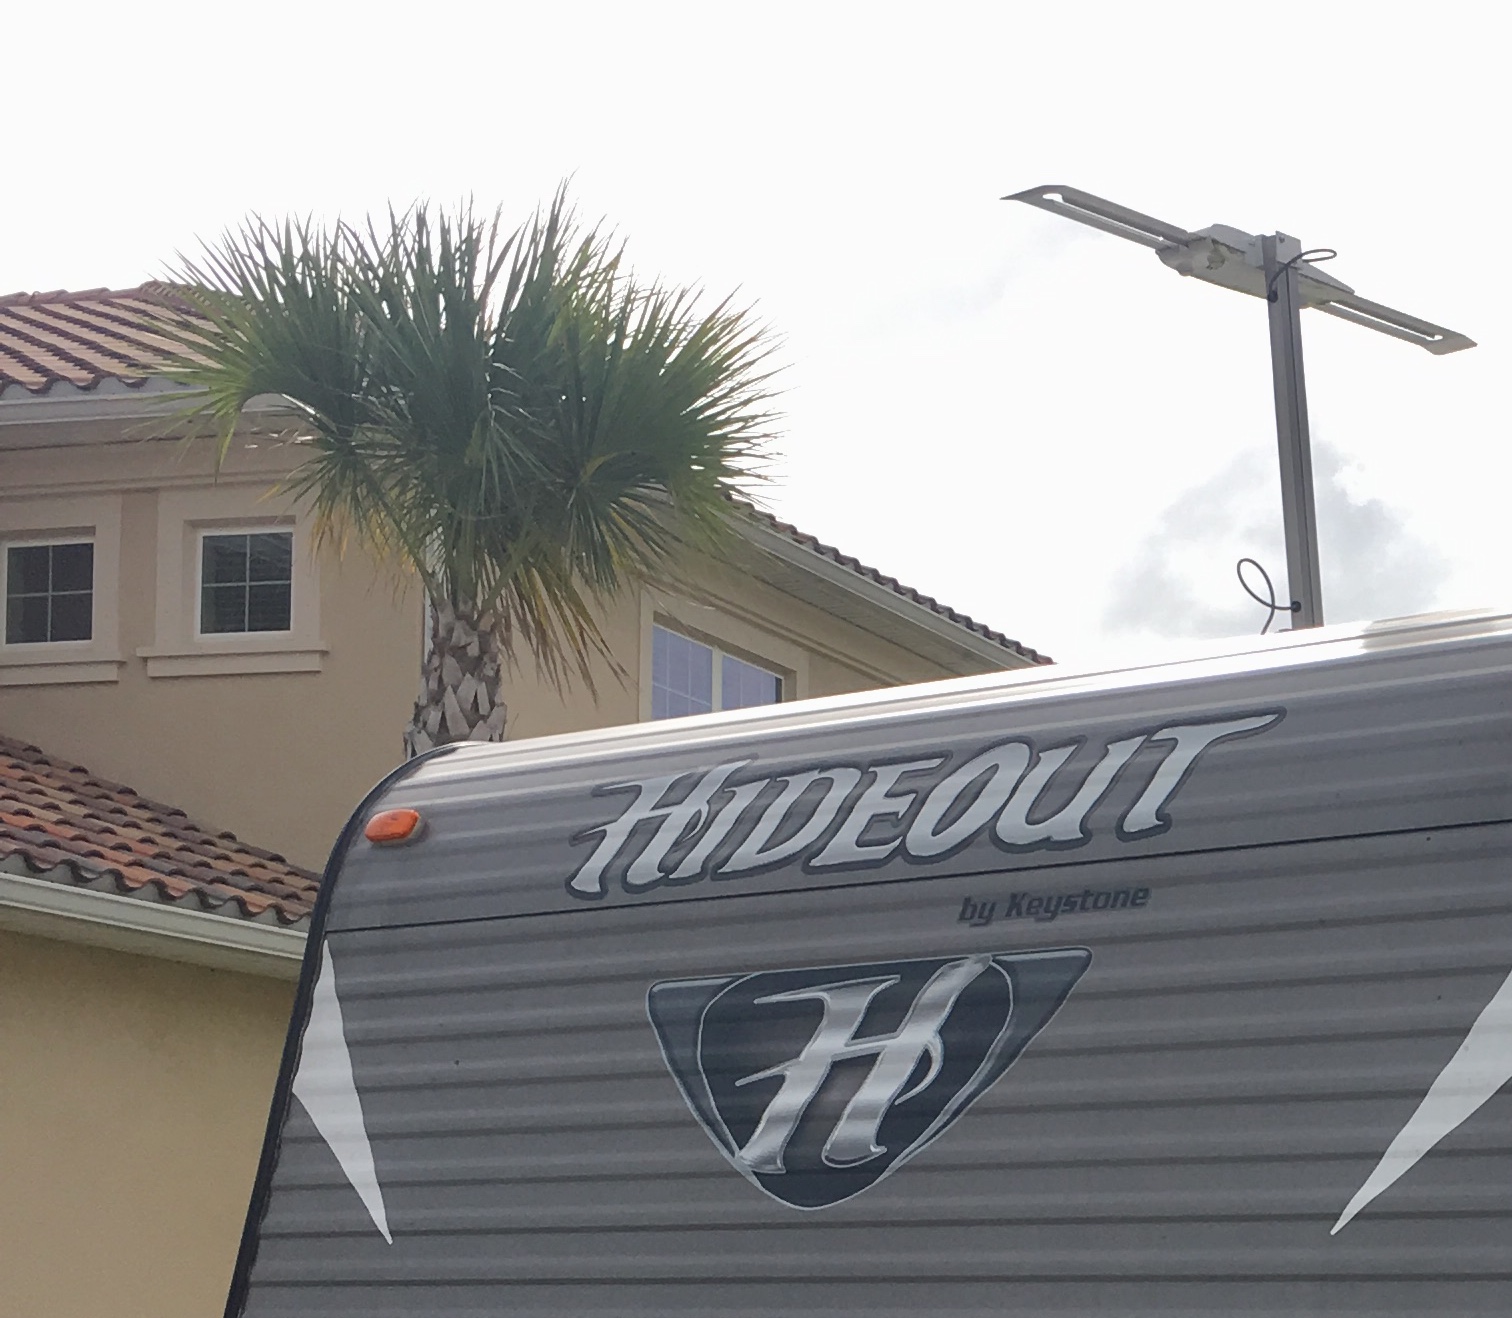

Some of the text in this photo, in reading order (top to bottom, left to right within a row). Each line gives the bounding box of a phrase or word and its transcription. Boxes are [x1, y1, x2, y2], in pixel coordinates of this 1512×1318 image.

[565, 706, 1287, 899] HIDEOUT
[957, 887, 1151, 927] by Keystone
